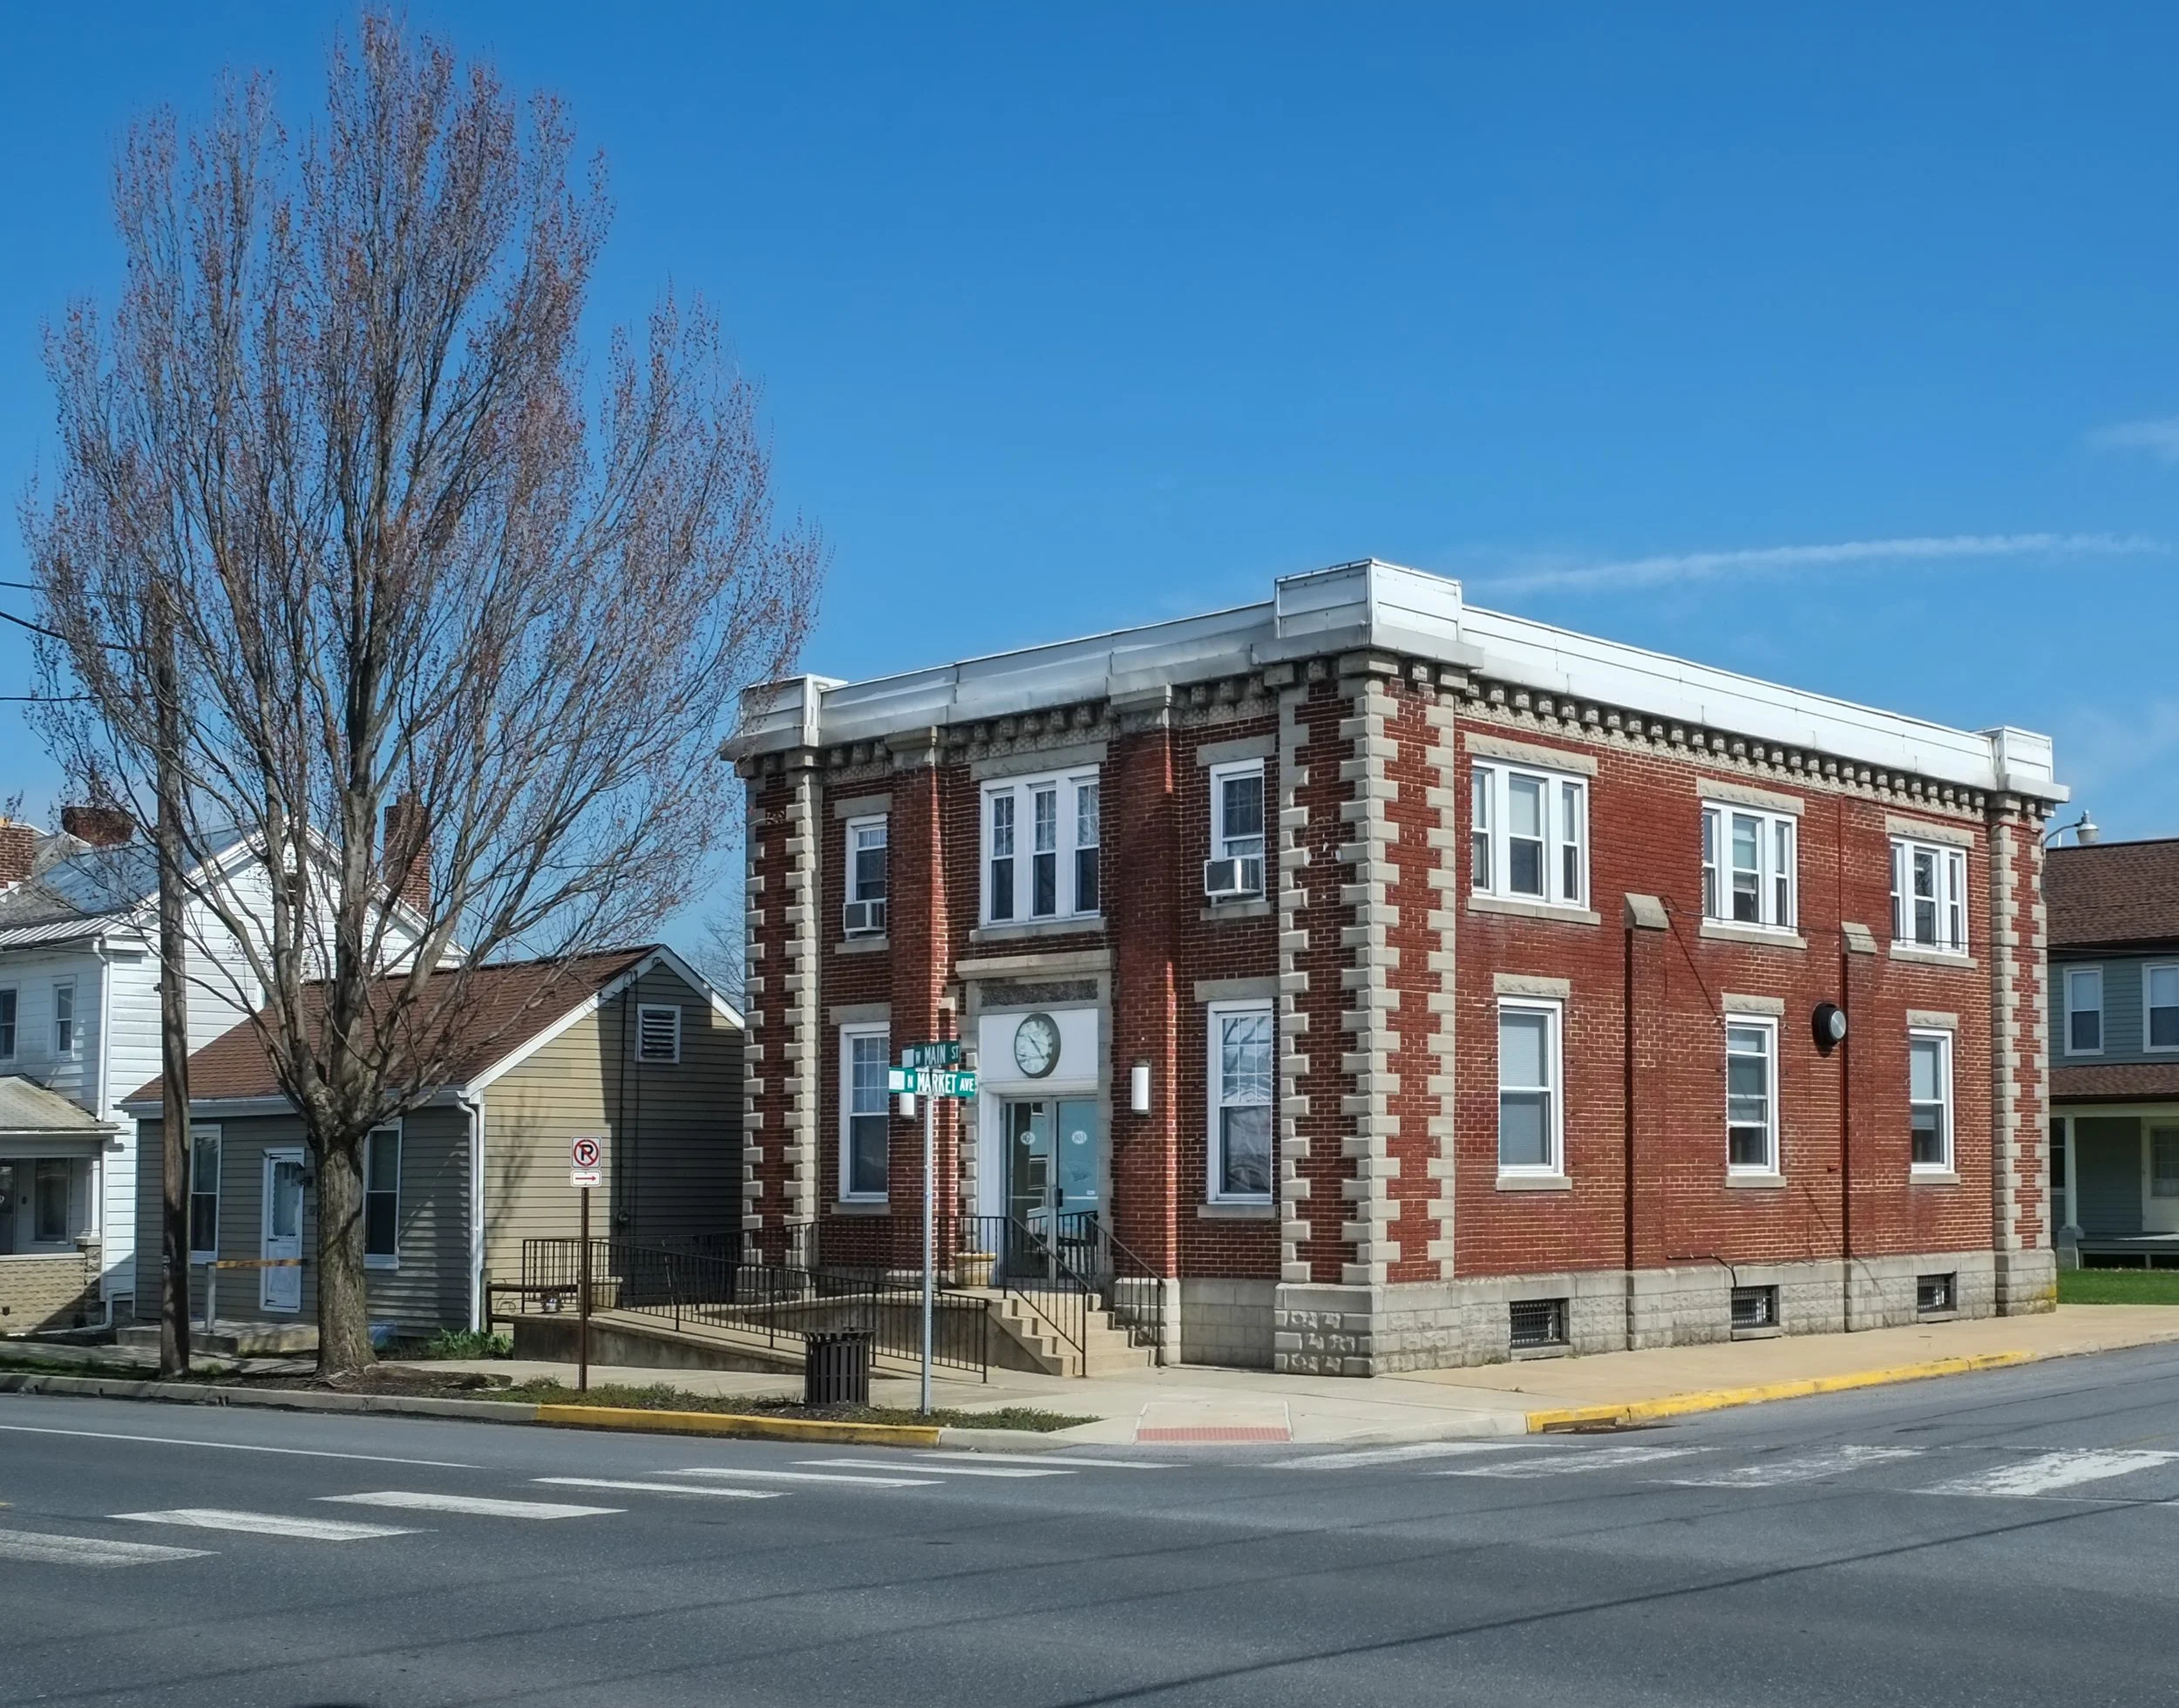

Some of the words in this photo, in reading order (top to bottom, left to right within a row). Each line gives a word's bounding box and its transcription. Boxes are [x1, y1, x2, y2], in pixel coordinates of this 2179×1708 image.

[915, 1051, 921, 1064] W
[924, 1045, 946, 1065] MAIN
[951, 1045, 959, 1059] ST
[907, 1074, 913, 1088] N
[917, 1073, 957, 1094] MARKET
[960, 1078, 974, 1092] AVE
